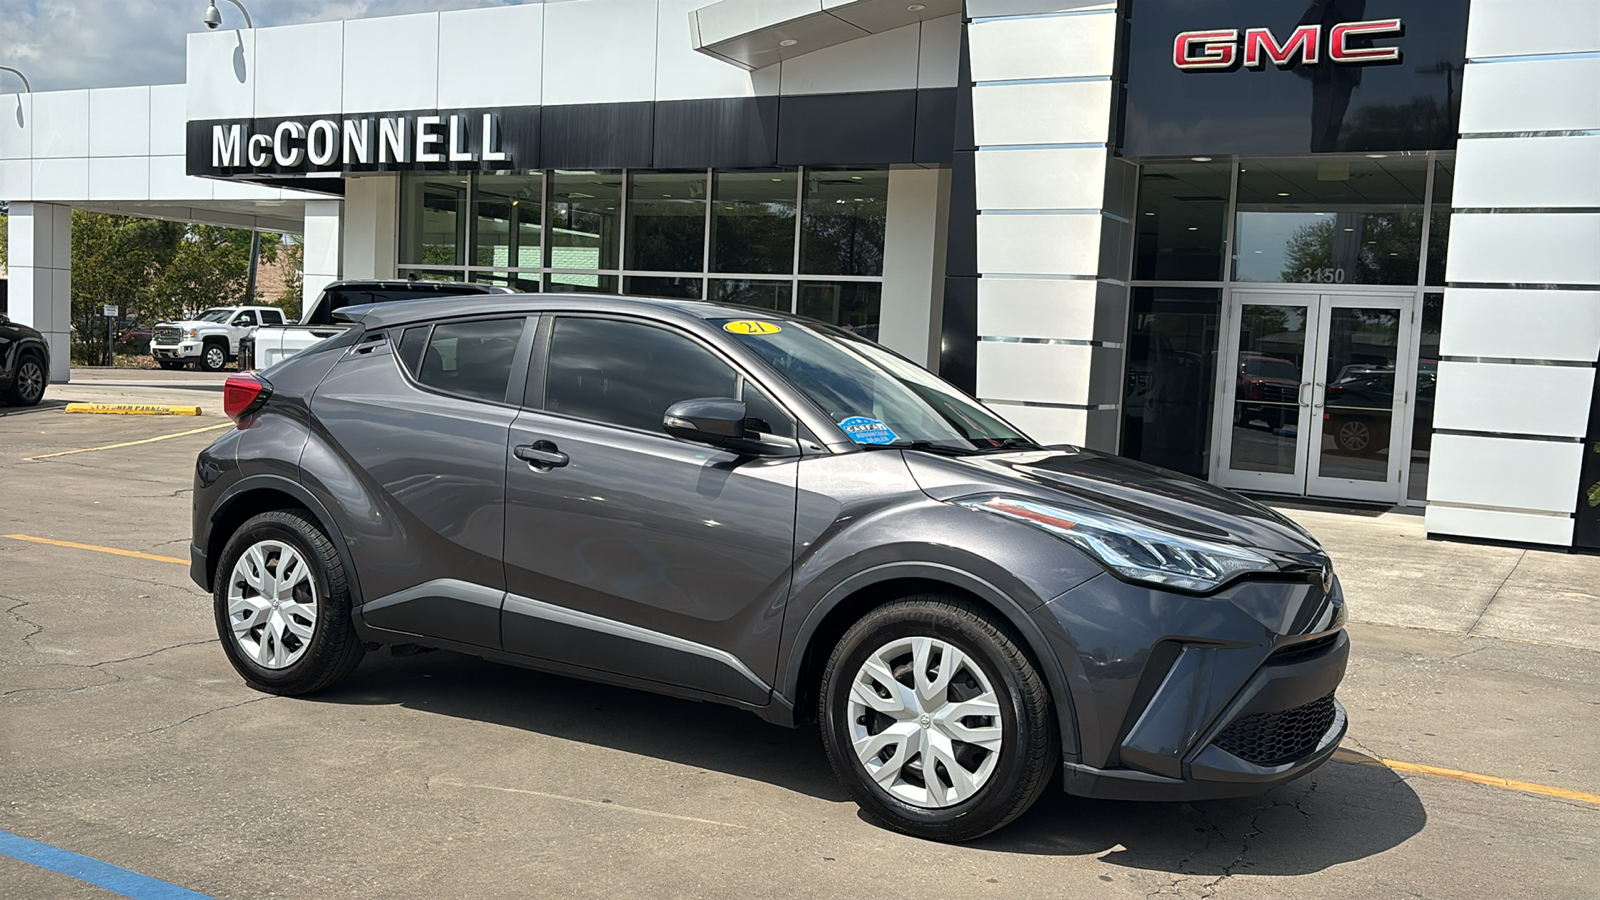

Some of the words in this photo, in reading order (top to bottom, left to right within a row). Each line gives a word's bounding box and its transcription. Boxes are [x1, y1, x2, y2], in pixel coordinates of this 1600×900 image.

[1173, 18, 1402, 69] GMC
[212, 113, 508, 168] McCONNELL
[1302, 267, 1345, 284] 3150
[740, 321, 767, 333] 21
